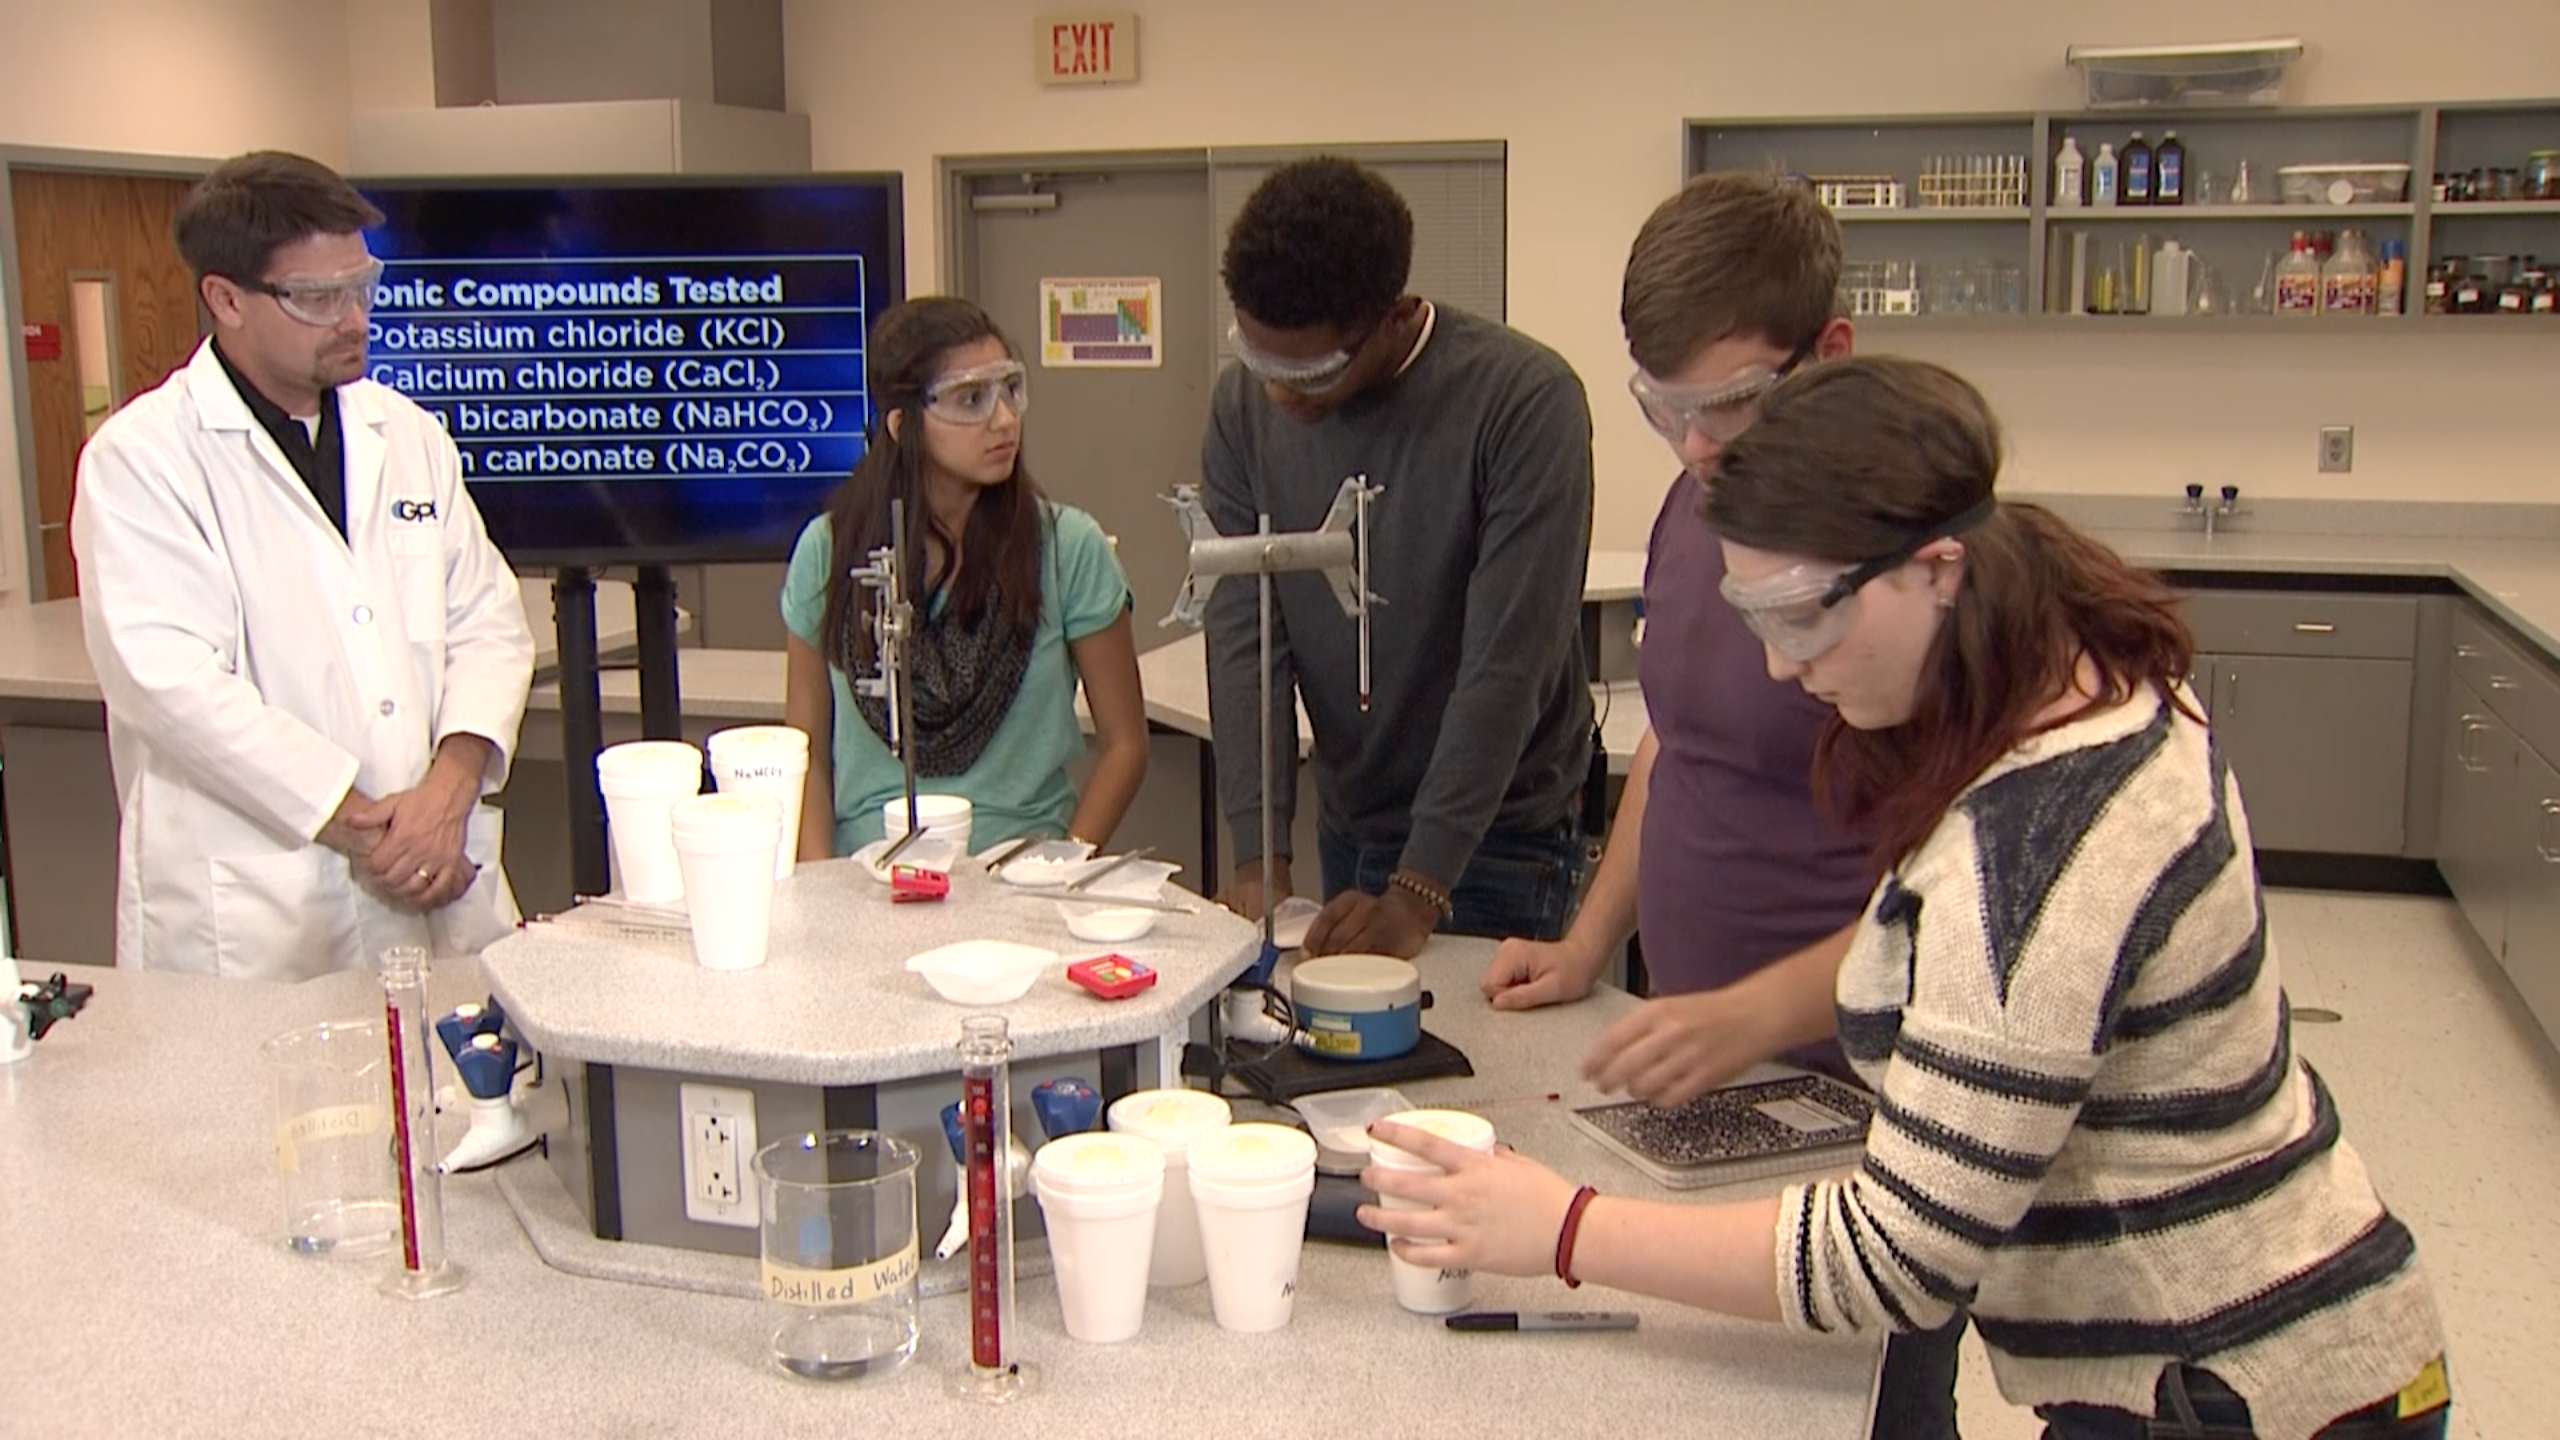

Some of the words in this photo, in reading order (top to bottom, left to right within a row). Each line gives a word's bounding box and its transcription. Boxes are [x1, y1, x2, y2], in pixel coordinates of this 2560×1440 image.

[1053, 22, 1115, 75] EXIT
[373, 278, 445, 308] onic
[454, 276, 660, 310] Compounds
[669, 273, 783, 304] Tested
[368, 320, 535, 349] Potassium
[548, 318, 685, 348] chloride
[700, 316, 785, 350] (KCl)
[371, 361, 506, 391] Calcium
[516, 360, 654, 390] chloride
[460, 402, 661, 431] bicarbonate
[486, 444, 655, 472] carbonate
[771, 1275, 853, 1303] Distilled
[873, 1253, 915, 1291] Water
